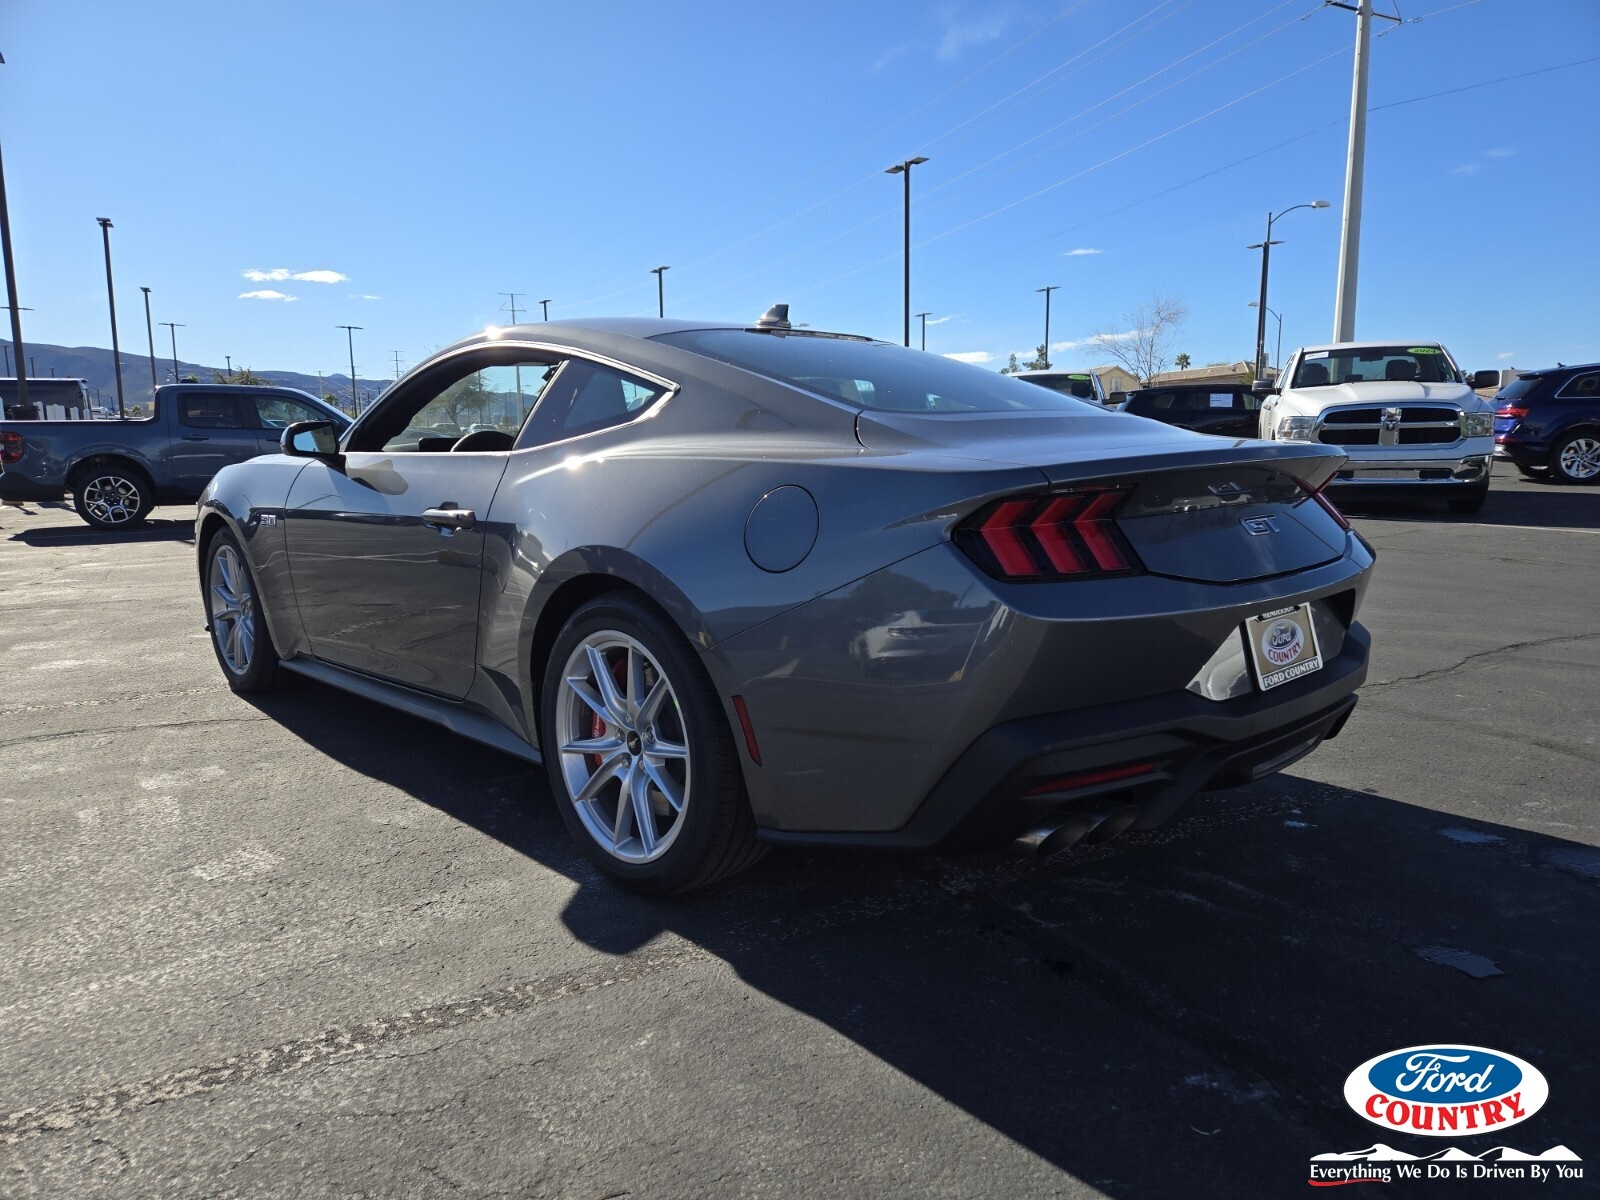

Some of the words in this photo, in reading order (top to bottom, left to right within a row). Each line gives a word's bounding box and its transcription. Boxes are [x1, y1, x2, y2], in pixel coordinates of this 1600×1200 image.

[1240, 514, 1280, 536] GT
[1272, 626, 1293, 646] Ford
[1268, 641, 1301, 662] COUNTRY
[1264, 673, 1285, 687] FORD
[1285, 660, 1319, 679] COUNTRY
